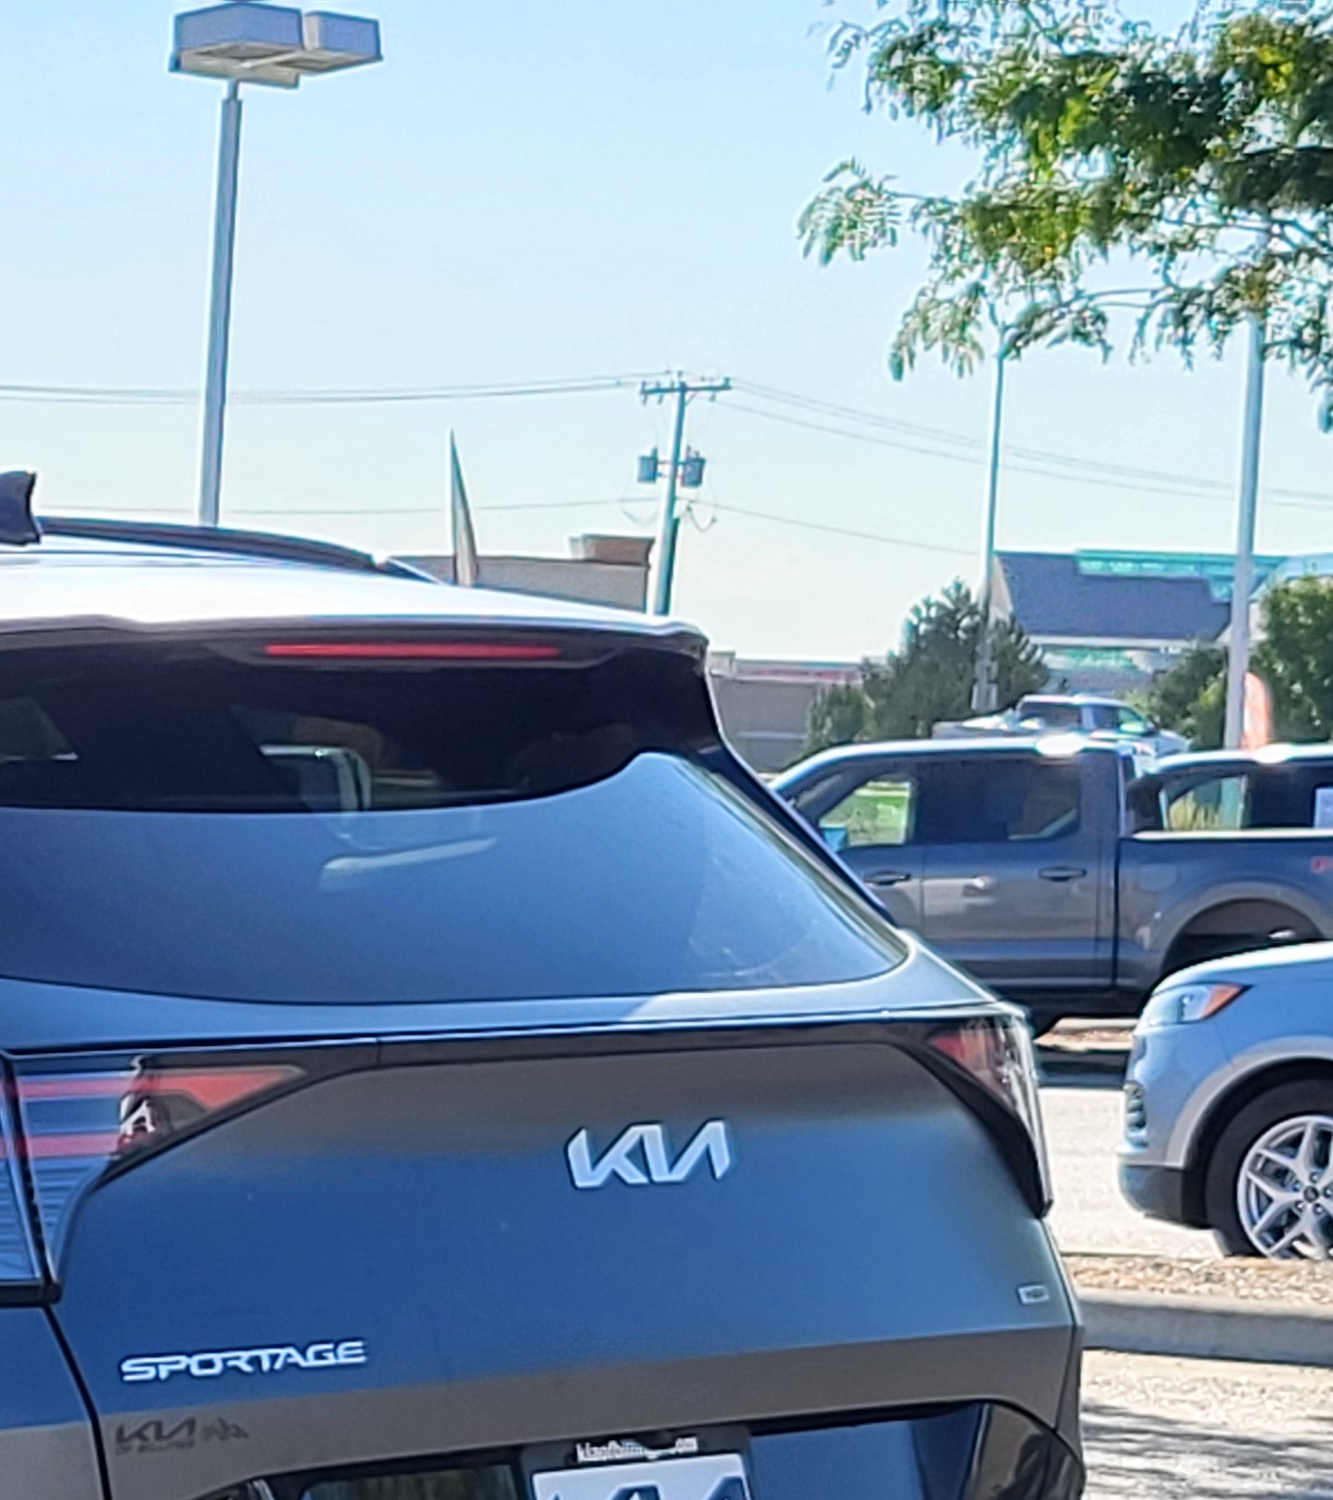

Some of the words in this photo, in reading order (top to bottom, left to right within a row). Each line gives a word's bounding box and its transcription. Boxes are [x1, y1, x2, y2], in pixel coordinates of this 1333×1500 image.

[567, 1120, 730, 1188] KIA
[120, 1340, 367, 1381] SPORTAGE
[115, 1416, 196, 1443] KIA
